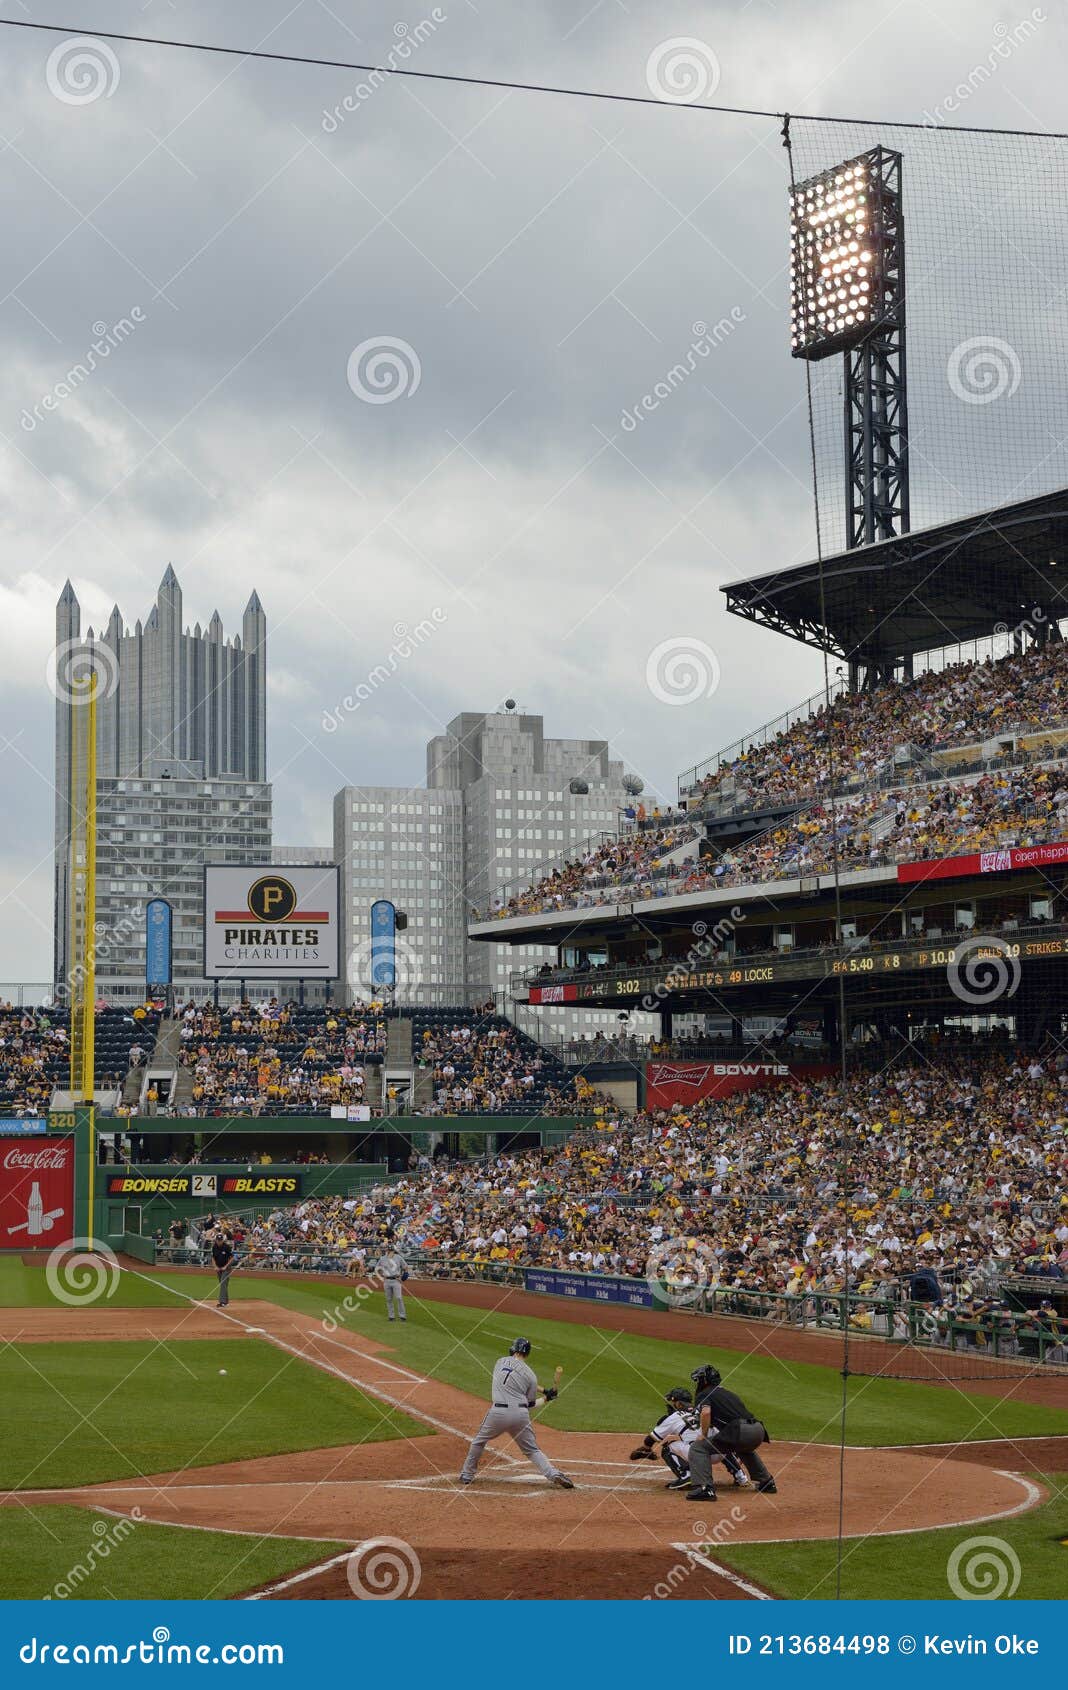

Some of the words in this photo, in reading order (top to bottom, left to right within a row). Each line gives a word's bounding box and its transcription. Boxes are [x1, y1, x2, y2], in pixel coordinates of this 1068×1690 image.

[1015, 851, 1038, 863] open
[1040, 845, 1068, 860] happi
[264, 887, 282, 913] P
[224, 929, 319, 946] PIRATES
[224, 948, 319, 959] CHARITIES
[729, 970, 742, 983] 49
[744, 967, 774, 982] LOCKE
[850, 958, 873, 972] 5.40
[893, 955, 900, 967] 8
[931, 950, 955, 964] 10.0
[978, 947, 1002, 959] BALLS
[1006, 944, 1020, 957] 19
[1026, 941, 1062, 954] STRIKES
[616, 980, 640, 994] 3:02
[714, 1065, 789, 1075] BOWTIE
[49, 1113, 76, 1127] 320
[122, 1178, 189, 1192] BOWSER
[236, 1178, 296, 1192] BLASTS
[502, 1368, 513, 1385] 7
